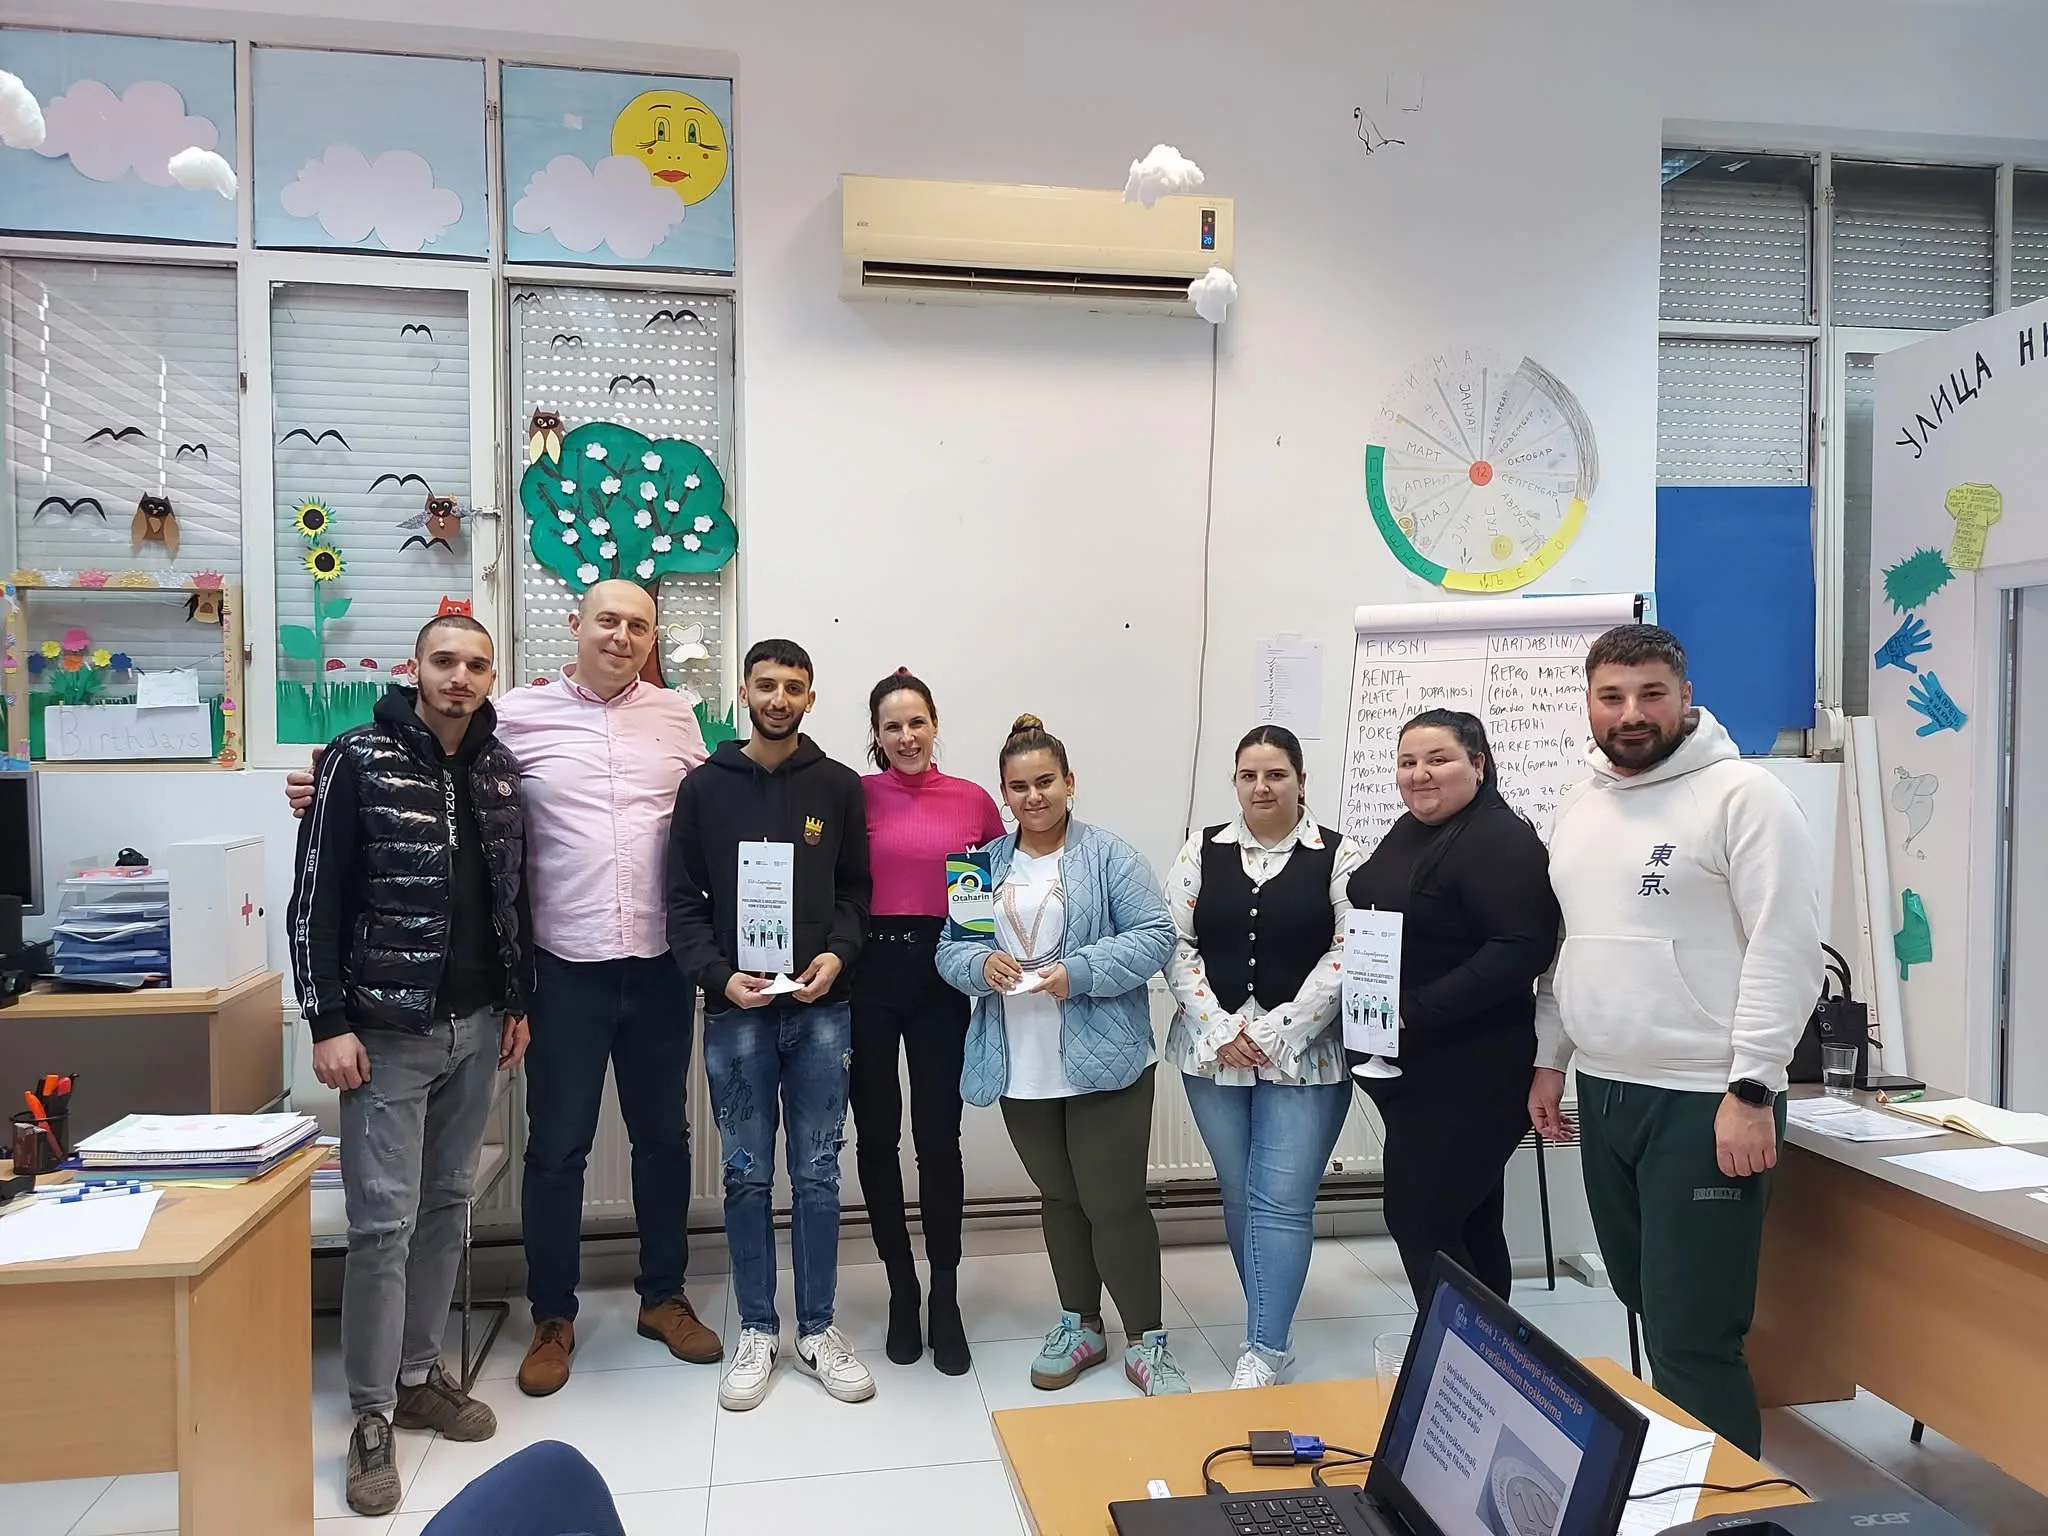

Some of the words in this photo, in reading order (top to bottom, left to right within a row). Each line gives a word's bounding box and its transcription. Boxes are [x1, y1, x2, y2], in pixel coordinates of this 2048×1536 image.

[1896, 351, 1993, 459] УЛИЦА
[1508, 448, 1553, 466] ОКТОБАР
[1501, 493, 1532, 529] АВГУСТ
[1366, 638, 1427, 657] FIKSNI
[1362, 669, 1411, 687] RENTA
[1491, 664, 1528, 681] REPRO
[1539, 664, 1585, 680] MATERI
[60, 710, 200, 757] Birthdays
[1350, 782, 1399, 797] MARKETI
[307, 848, 317, 872] BOSS
[1637, 843, 1677, 896] 東京
[951, 894, 990, 902] Otaharin
[1475, 1313, 1494, 1337] Korak
[1502, 1337, 1541, 1378] Prikupljanje
[1541, 1371, 1583, 1415] informacija
[1484, 1346, 1523, 1386] varijabilnim
[1446, 1362, 1469, 1391] Varijabilni
[1469, 1384, 1490, 1410] troškovi
[1430, 1414, 1440, 1429] Ako
[1445, 1430, 1465, 1456] troškovi
[1850, 1512, 1911, 1527] acer
